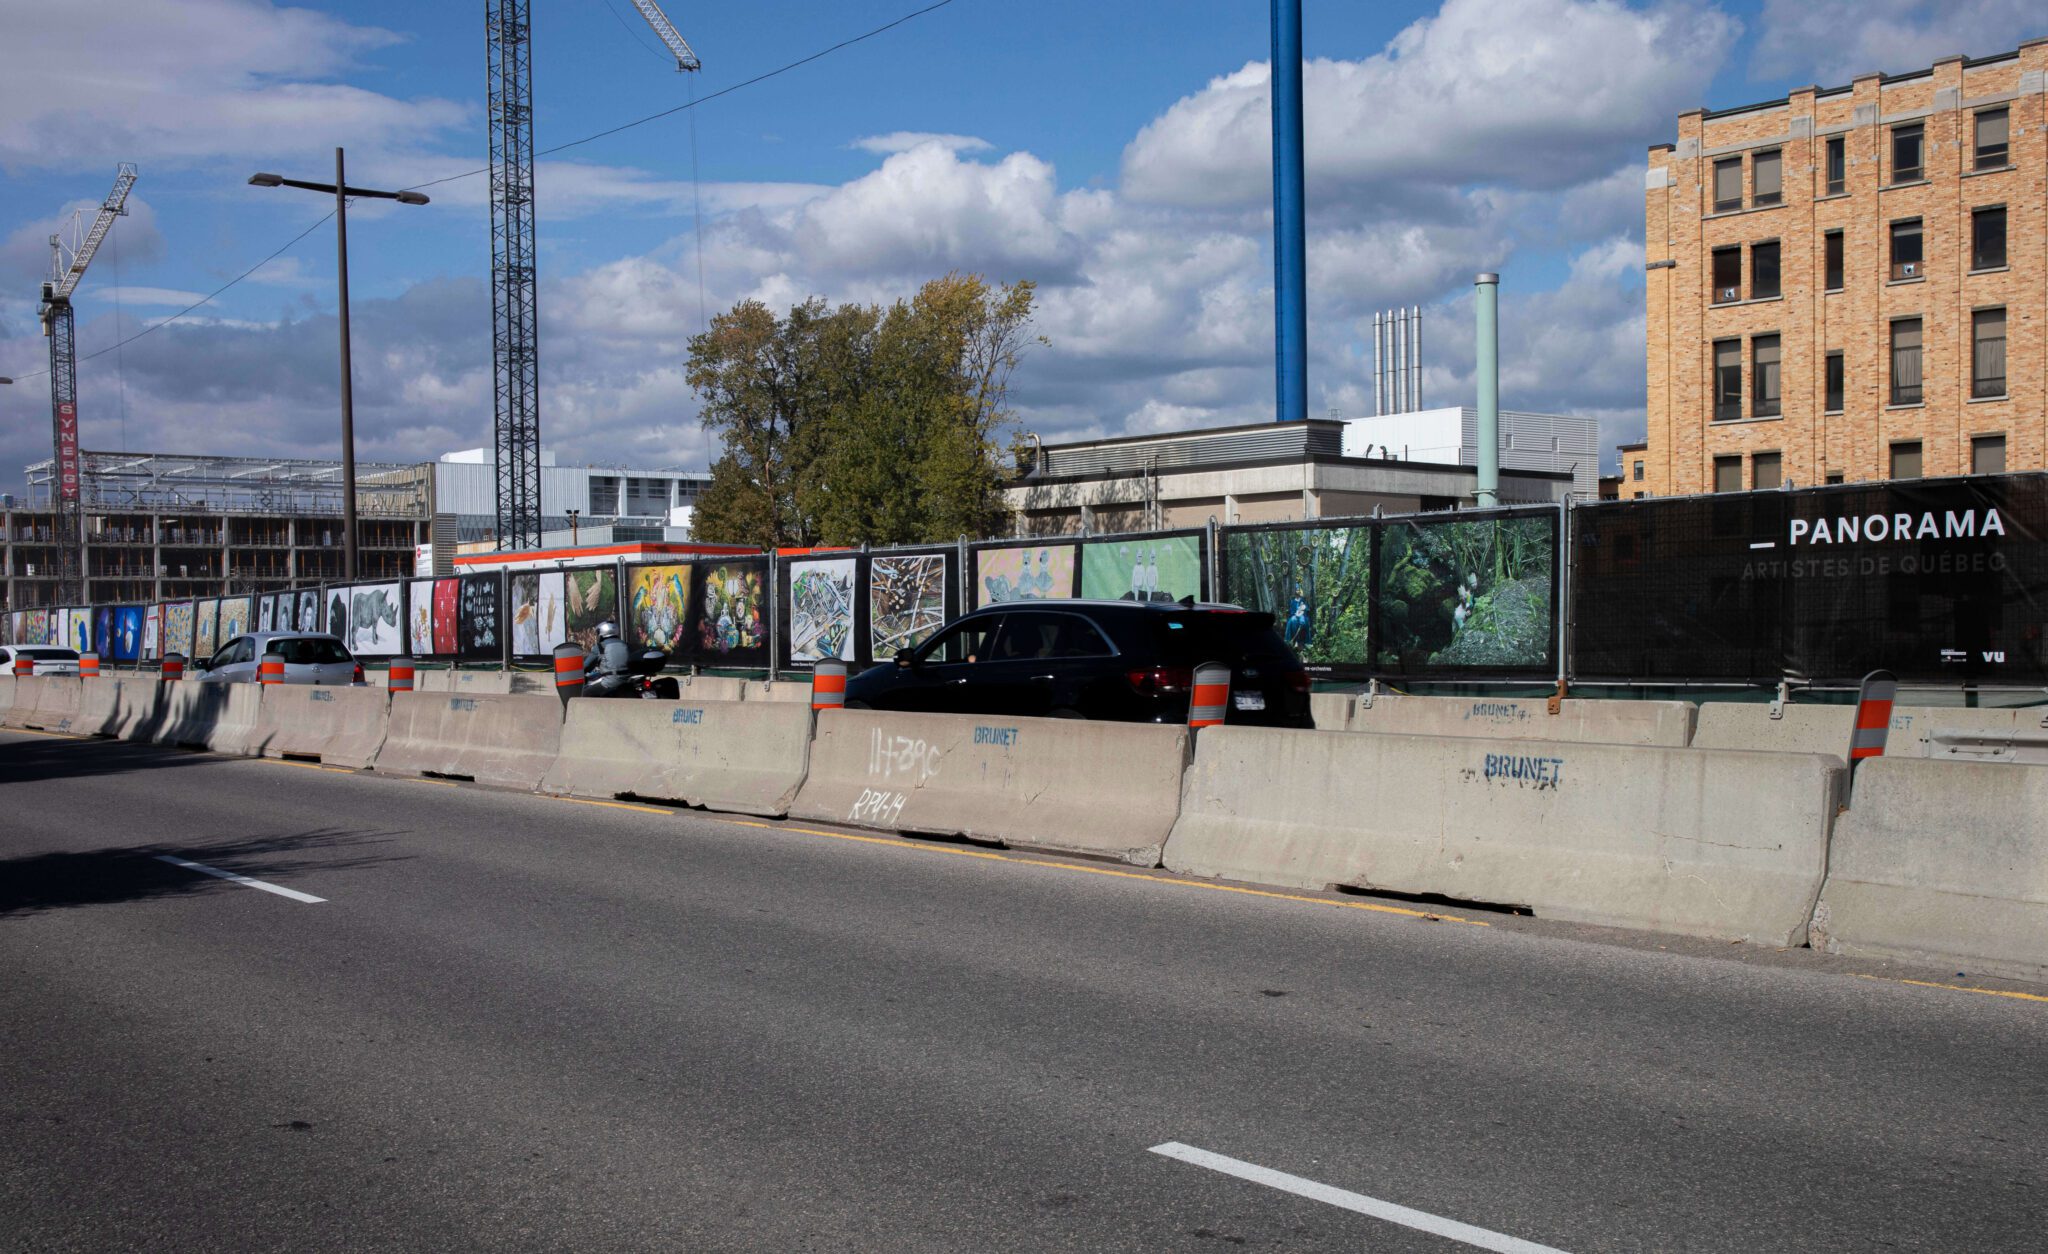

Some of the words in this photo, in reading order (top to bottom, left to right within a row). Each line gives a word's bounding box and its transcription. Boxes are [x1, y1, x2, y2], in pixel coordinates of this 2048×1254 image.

[61, 405, 77, 497] SYNERGY
[1790, 508, 2006, 546] PANORAMA
[1743, 558, 1850, 581] ARTISTES
[1859, 556, 1891, 576] DE
[1899, 550, 2006, 575] QUÉBEC
[672, 708, 704, 725] BRUNET
[1472, 703, 1518, 717] BRUNET
[974, 726, 1019, 746] BRUNET
[1485, 753, 1563, 784] BRUNET
